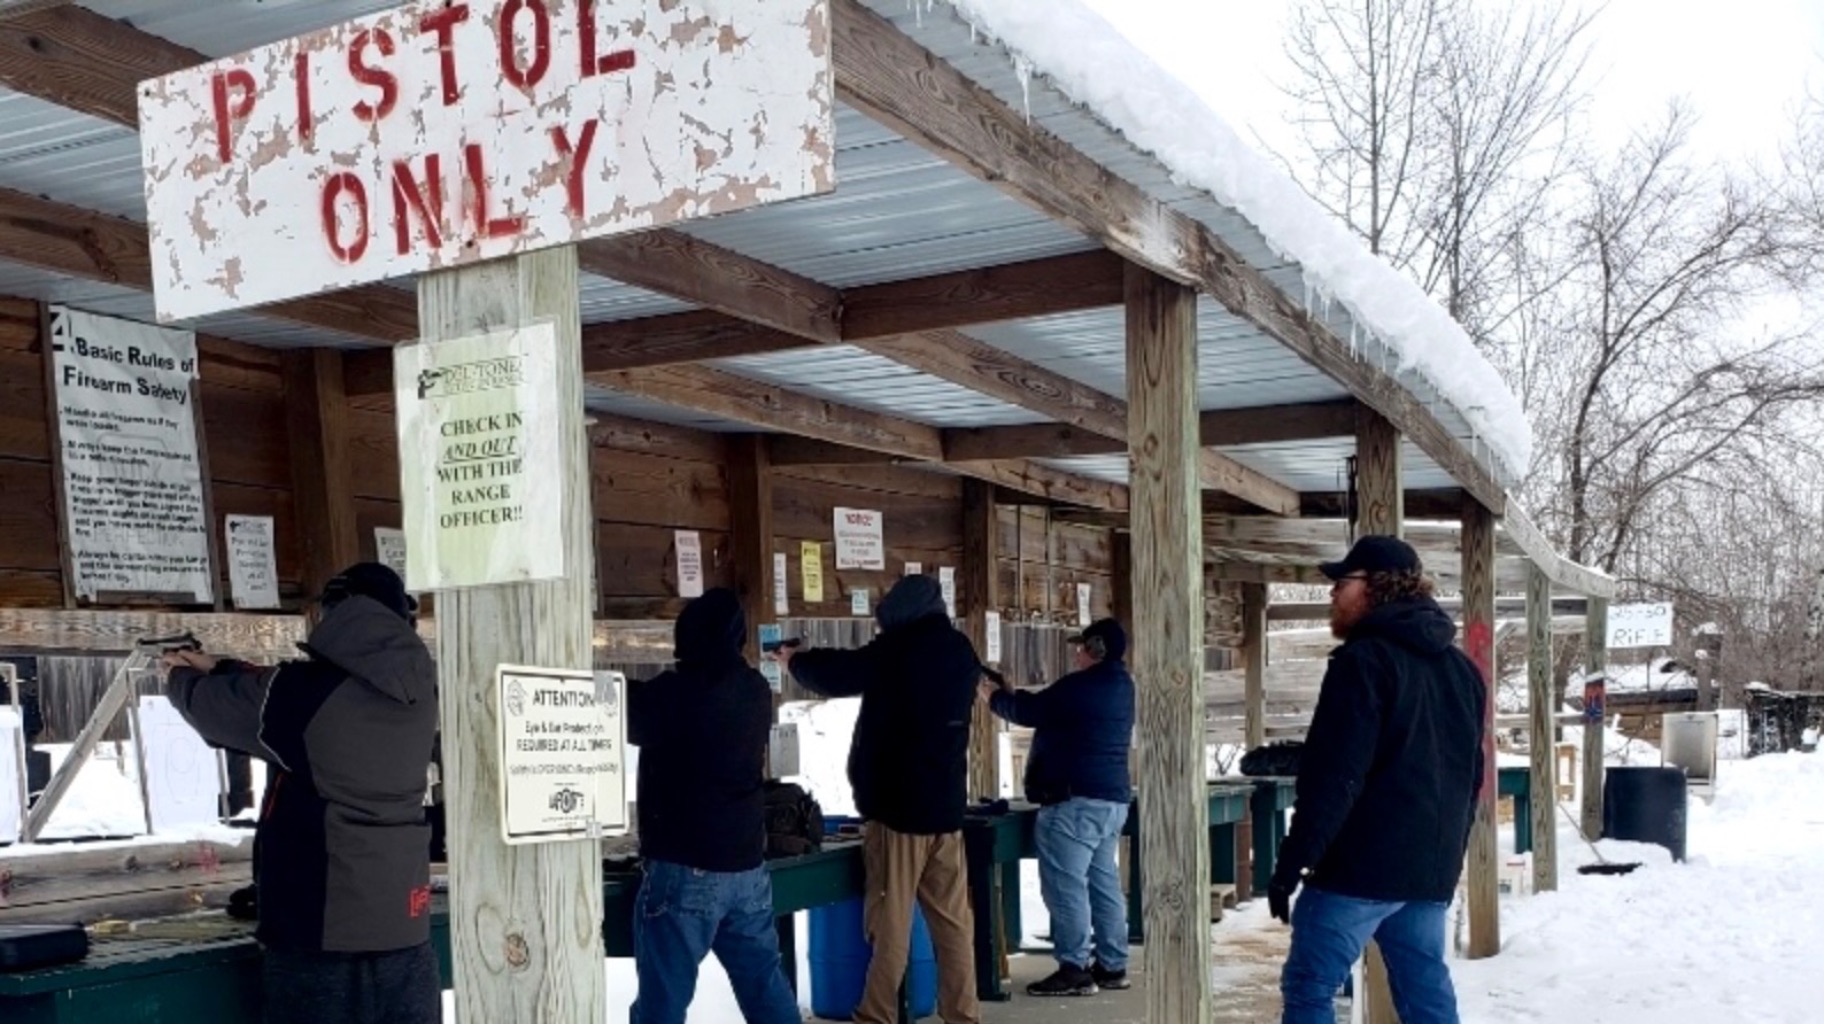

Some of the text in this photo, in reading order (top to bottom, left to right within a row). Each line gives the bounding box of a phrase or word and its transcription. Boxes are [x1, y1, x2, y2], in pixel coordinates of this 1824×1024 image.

[211, 0, 637, 163] PISTOL
[321, 119, 599, 265] ONLY
[75, 337, 123, 364] Basic
[128, 346, 174, 370] Rules
[181, 358, 194, 373] of
[63, 364, 187, 405] Firearm Safety
[440, 411, 522, 437] CHECK IN
[443, 435, 517, 461] AND OUT
[437, 458, 522, 483] WITH THE
[451, 484, 511, 506] RANGE
[440, 505, 523, 529] OFFICER!!
[532, 689, 595, 708] ATTENTION
[525, 720, 540, 737] Eye
